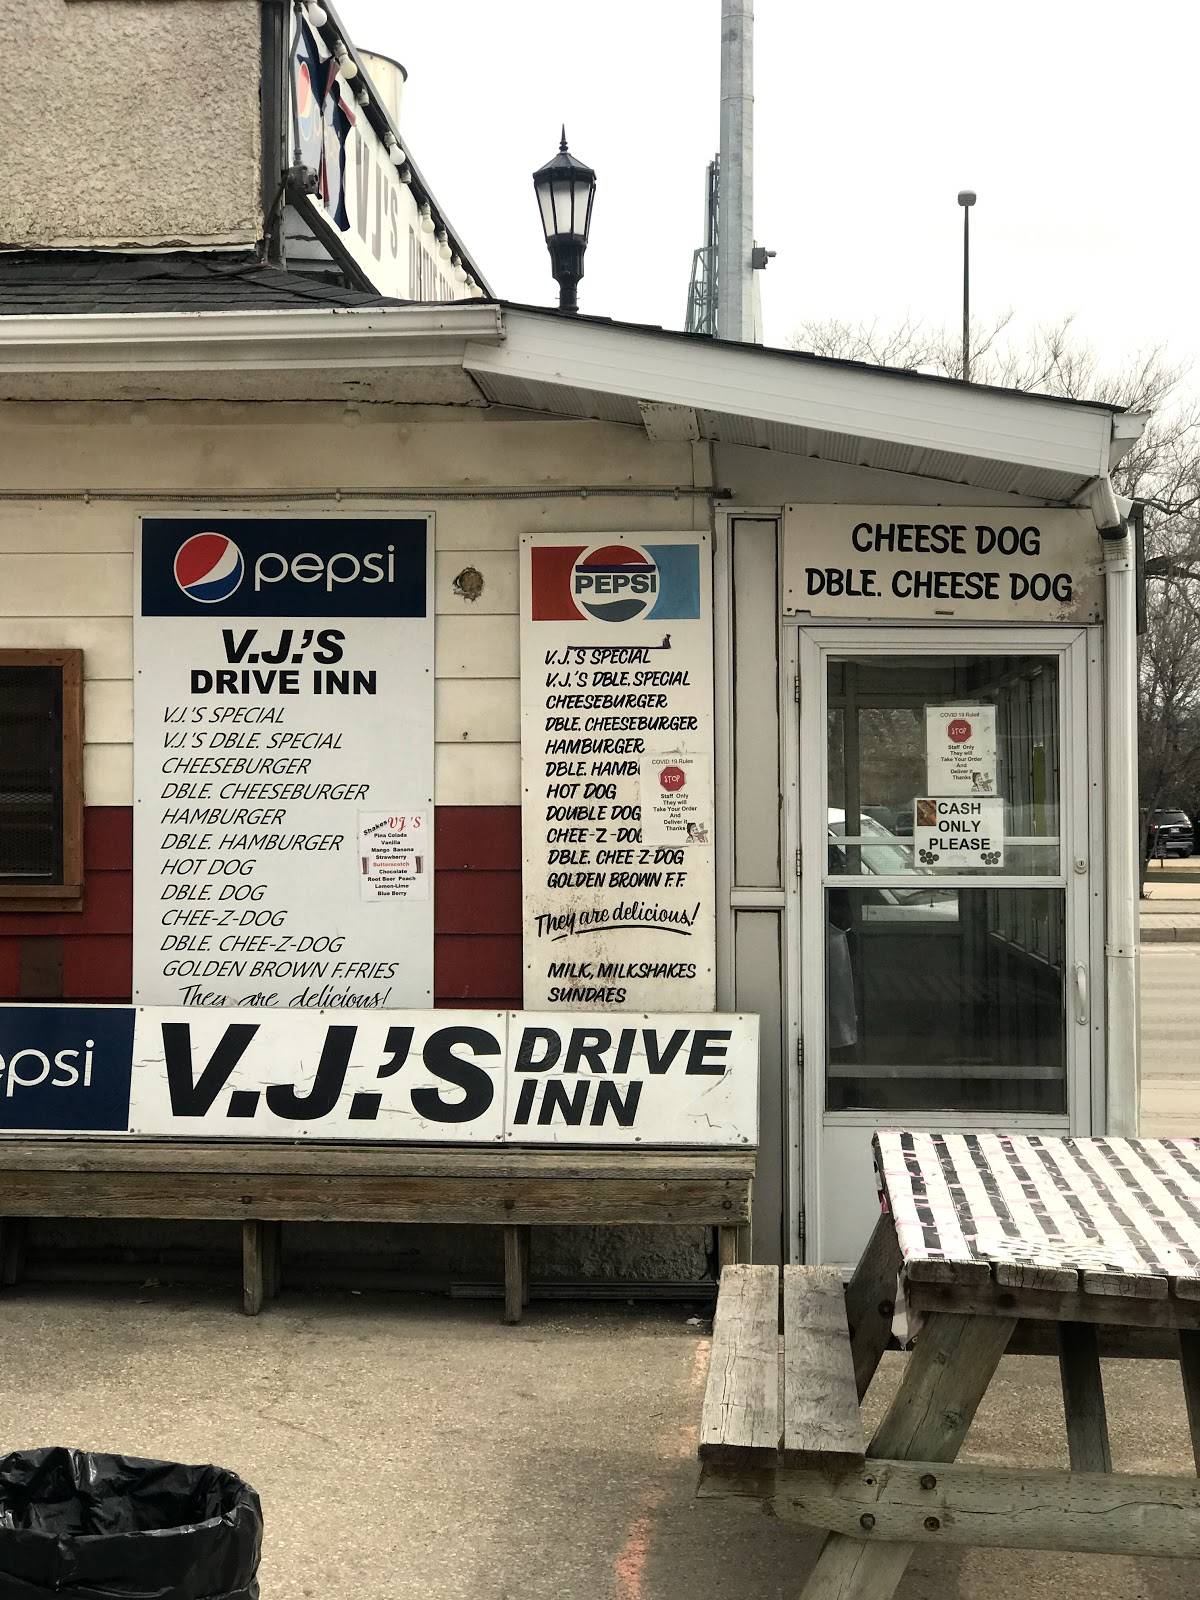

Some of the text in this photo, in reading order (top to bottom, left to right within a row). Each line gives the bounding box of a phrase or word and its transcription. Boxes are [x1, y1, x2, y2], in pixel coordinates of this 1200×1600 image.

[851, 522, 1041, 556] CHEESE DOG
[254, 544, 395, 592] pepsi
[575, 574, 657, 594] PEPSI
[805, 567, 1073, 602] DBLE. CHEESE DOG
[222, 629, 346, 665] V.J.'S
[590, 648, 651, 665] SPECIAL
[190, 669, 377, 695] DRIVE INN
[592, 671, 631, 687] DBLE.
[633, 670, 691, 687] SPECIAL
[545, 693, 668, 709] CHEESEBURGER
[163, 706, 286, 724] V.J.'S SPECIAL
[545, 715, 698, 732] DBLE. CHEESEBURGER
[951, 727, 967, 736] STOP
[163, 732, 344, 750] V.J.'S DBLE. SPECIAL
[545, 738, 645, 755] HAMBURGER
[161, 757, 312, 775] CHEESEBURGER
[545, 761, 587, 777] DBLE.
[664, 774, 681, 784] STOP
[161, 782, 370, 801] DBLE. CHEESEBURGER
[546, 783, 617, 800] HOT DOG
[160, 808, 287, 825] HAMBURGER
[545, 805, 641, 821] DOUBLE DOG
[938, 802, 981, 815] CASH
[363, 820, 388, 836] Shakes
[938, 820, 981, 833] ONLY
[160, 833, 345, 851] DBLE. HAMBURGER
[929, 838, 991, 850] PLEASE
[548, 850, 591, 865] DBLE.
[160, 858, 257, 876] HOT DOG
[547, 872, 687, 889] GOLDEN BROWN F.F.
[160, 884, 268, 901] DBLE. DOG
[161, 909, 288, 927] CHEE-Z-DOG
[534, 901, 701, 938] They are delicious!
[160, 935, 346, 953] DBLE. CHEE-Z-DOG
[162, 960, 400, 979] GOLDEN BROWN F.FRIES
[547, 963, 696, 979] MILK, MILKSHAKES
[237, 992, 280, 1006] are
[288, 984, 392, 1008] delicious!
[547, 987, 626, 1003] SUNDAES
[513, 1026, 733, 1076] DRIVE
[161, 1022, 502, 1123] V.J.'S
[513, 1079, 644, 1127] INN
